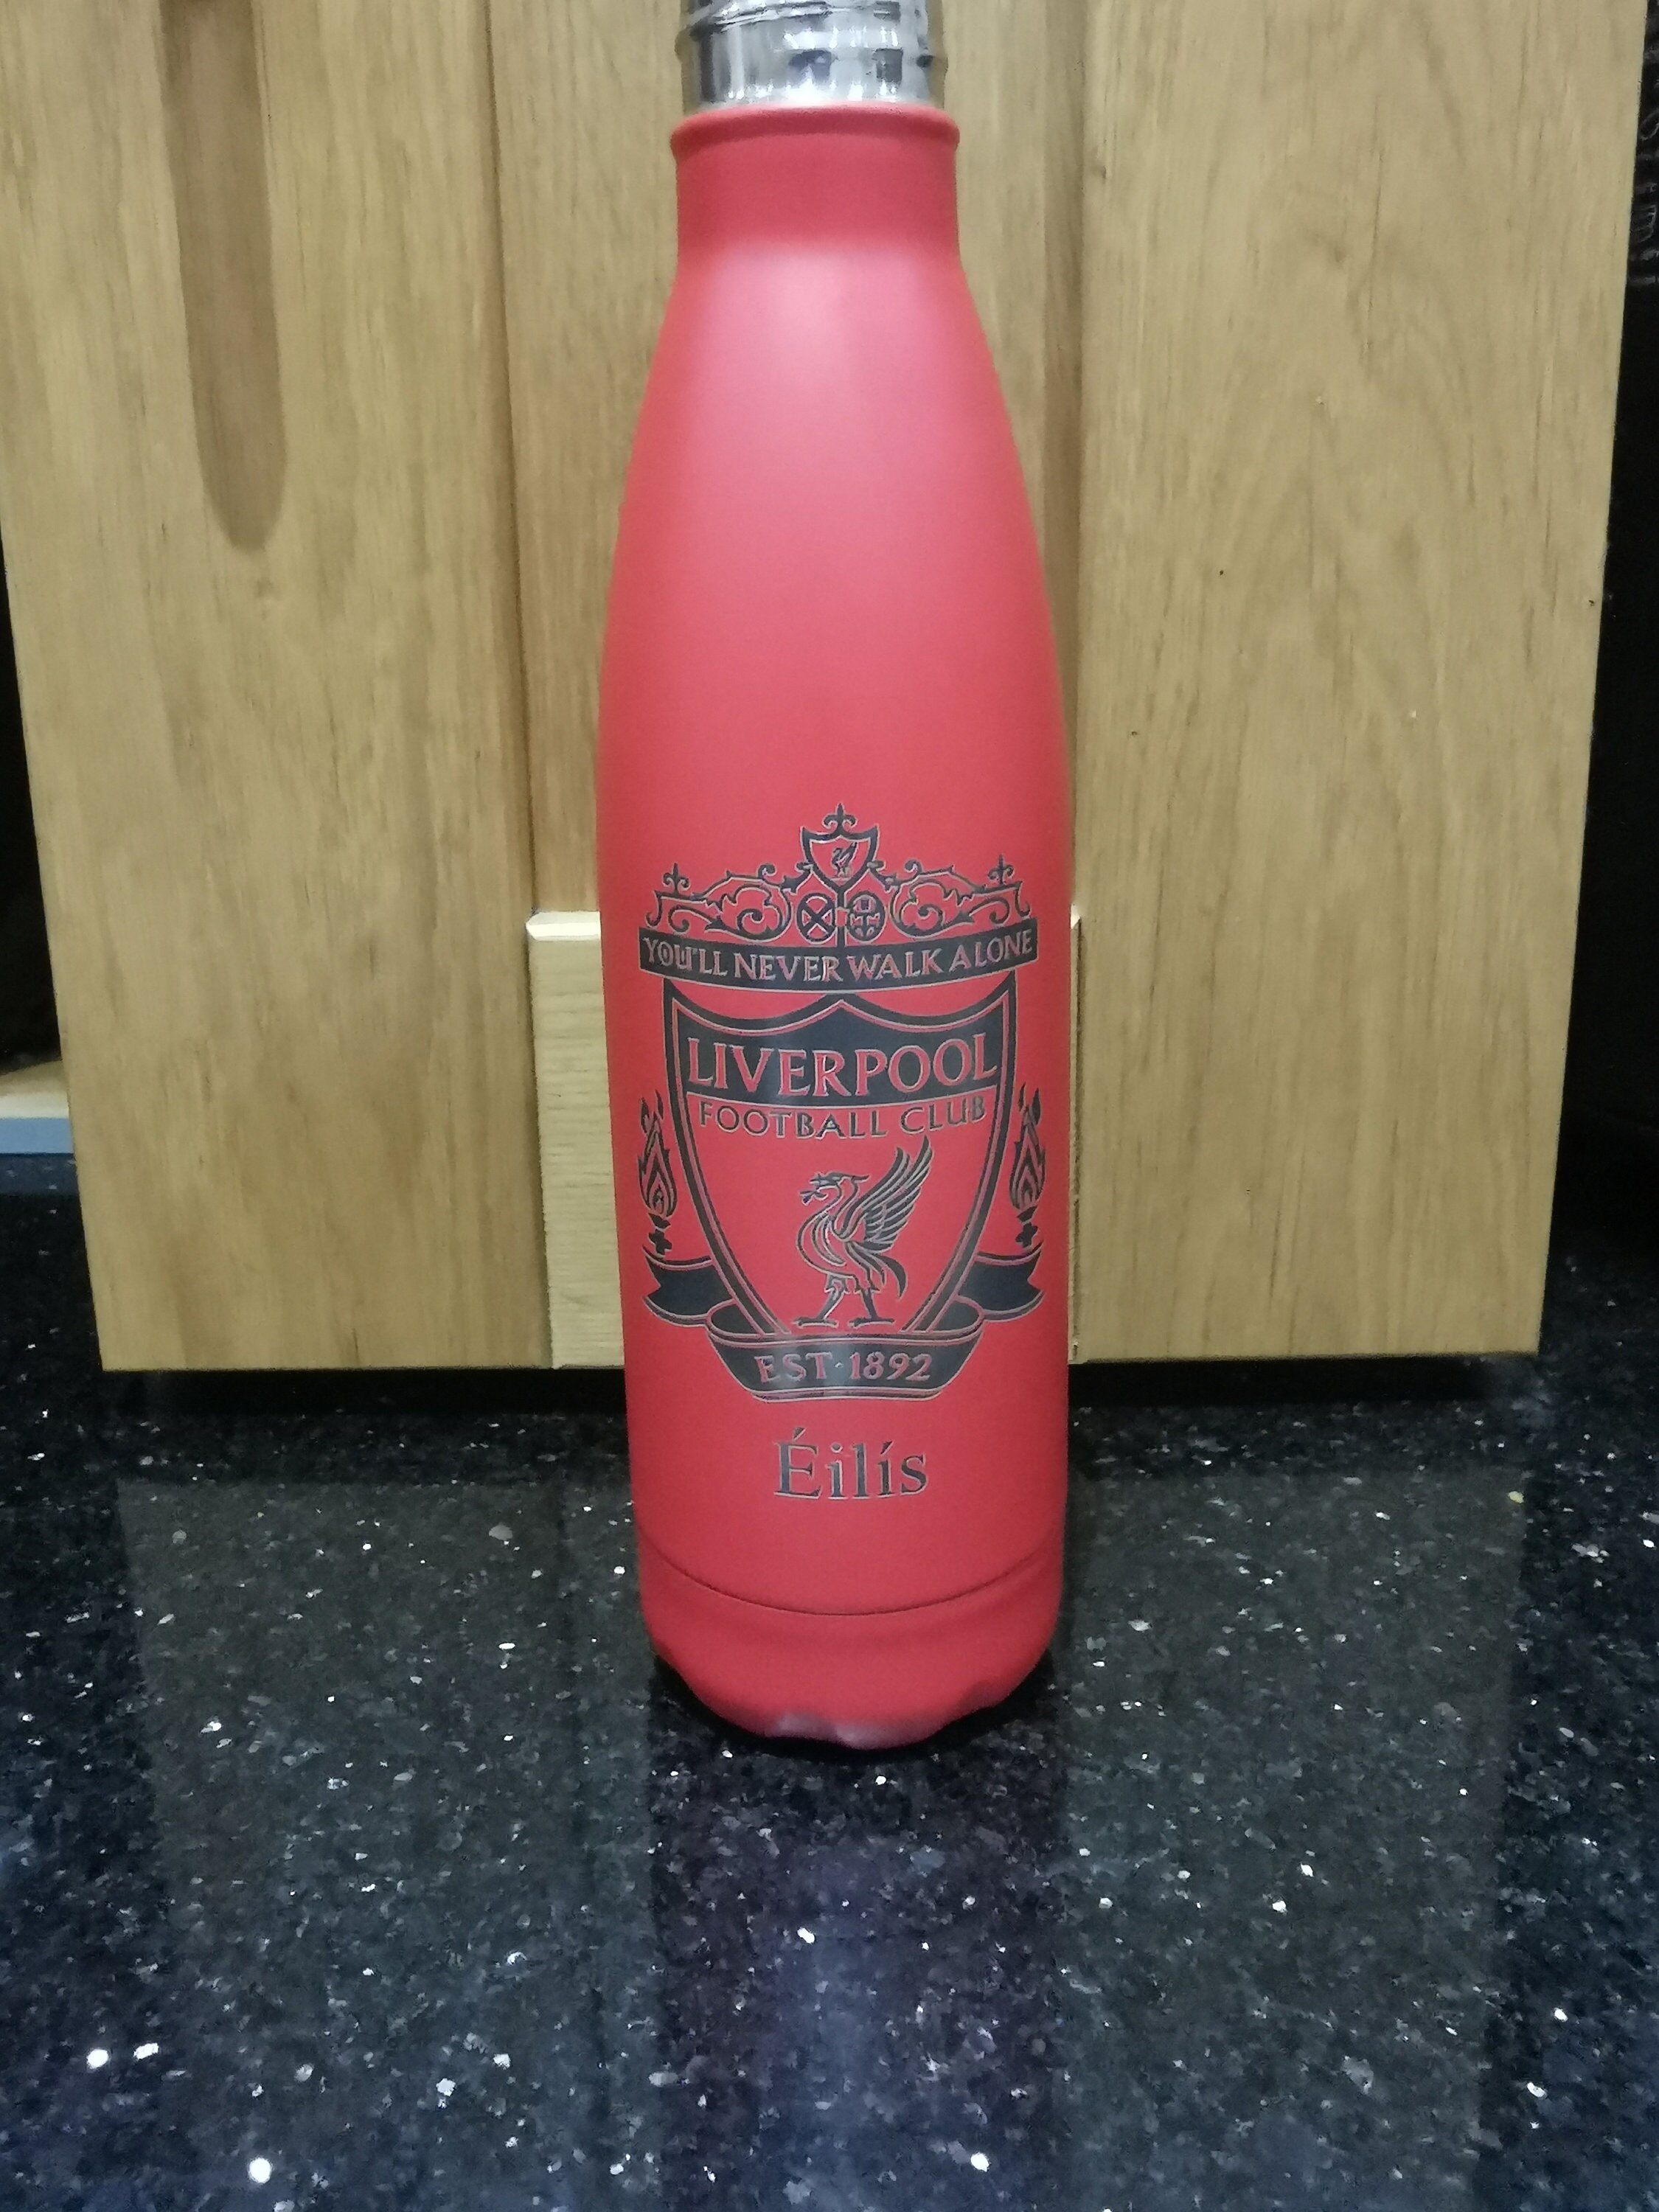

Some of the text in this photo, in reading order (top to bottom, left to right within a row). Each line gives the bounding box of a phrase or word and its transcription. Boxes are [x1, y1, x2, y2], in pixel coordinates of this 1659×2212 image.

[643, 928, 1033, 982] YOU'LL NEVER WALK ALONE
[687, 1032, 998, 1098] LIVERPOOL
[699, 1094, 986, 1139] FOOTBALL CLUB
[773, 1426, 928, 1500] Éilís
